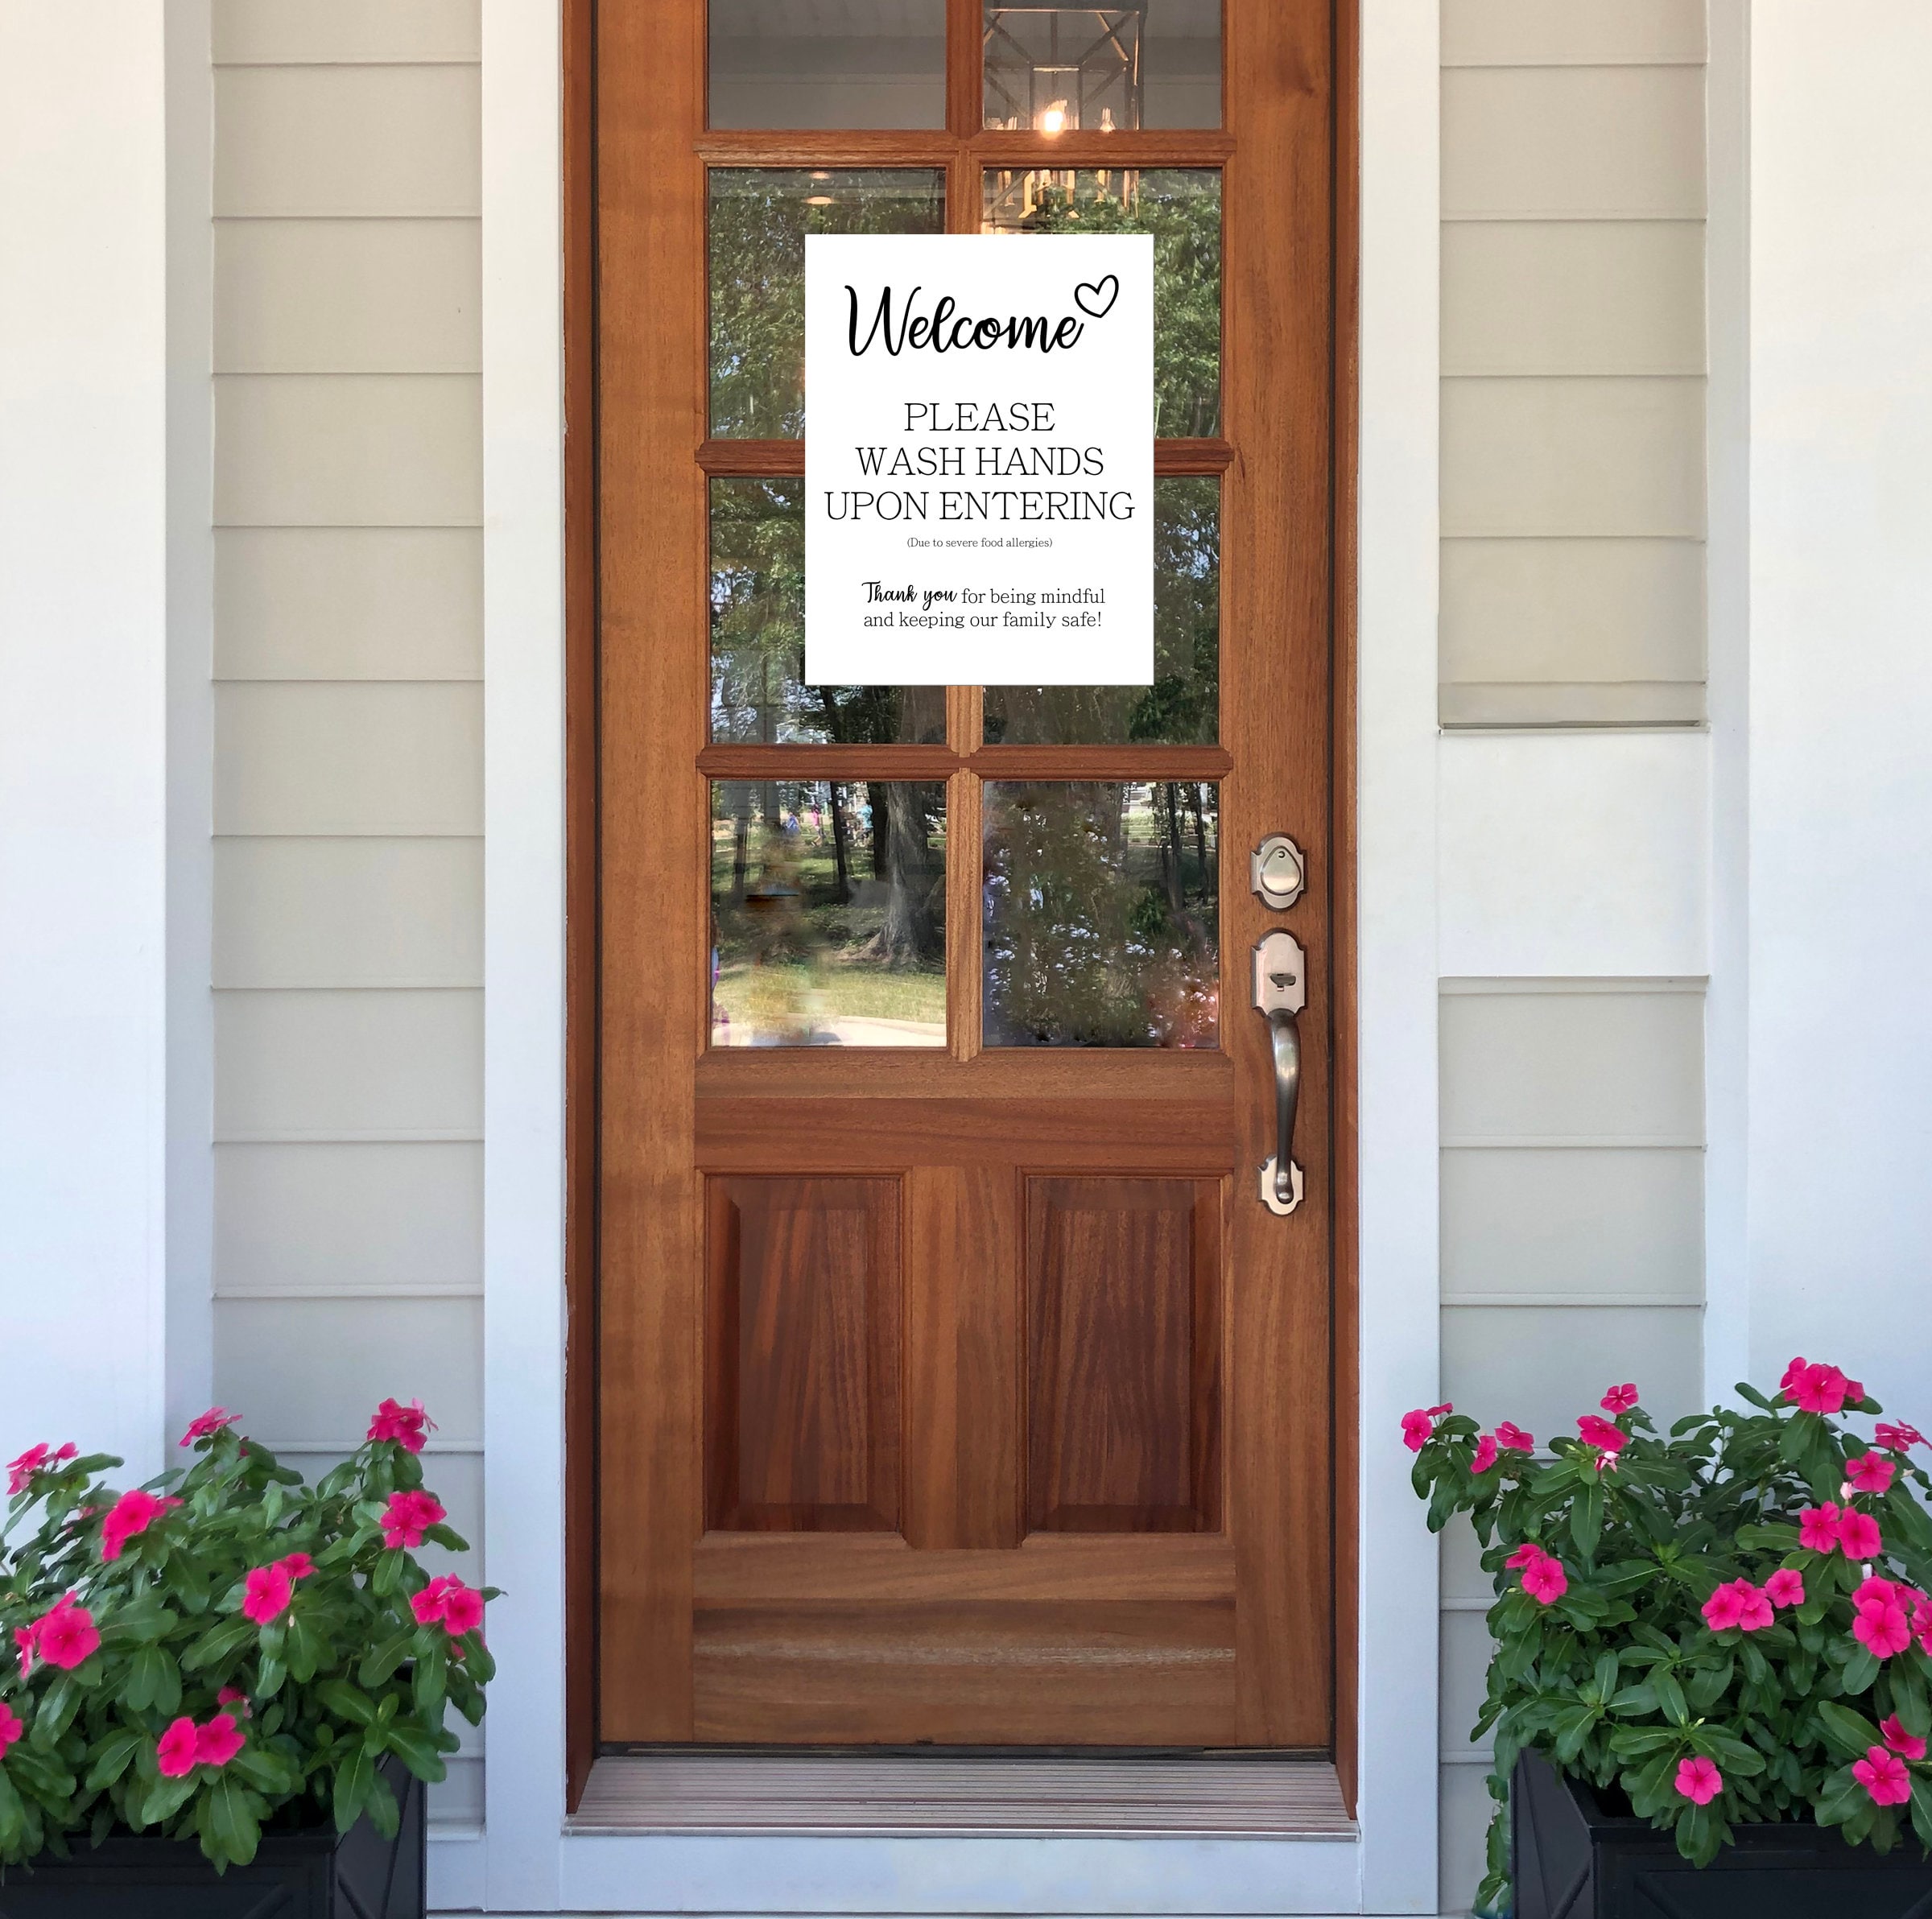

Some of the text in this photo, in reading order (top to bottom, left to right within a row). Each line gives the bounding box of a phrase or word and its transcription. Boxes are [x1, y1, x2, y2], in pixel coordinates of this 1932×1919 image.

[844, 284, 1085, 357] Welcome
[904, 402, 1055, 431] PLEASE
[854, 447, 1104, 477] WASH HANDS
[824, 491, 1136, 521] UPON ENTERING
[906, 537, 931, 548] (Due
[932, 539, 943, 547] to
[980, 537, 1004, 547] food
[1005, 537, 1053, 548] allergies)
[861, 580, 1106, 612] Thank you for being mindful
[864, 611, 1101, 629] and keeping our family safe!
